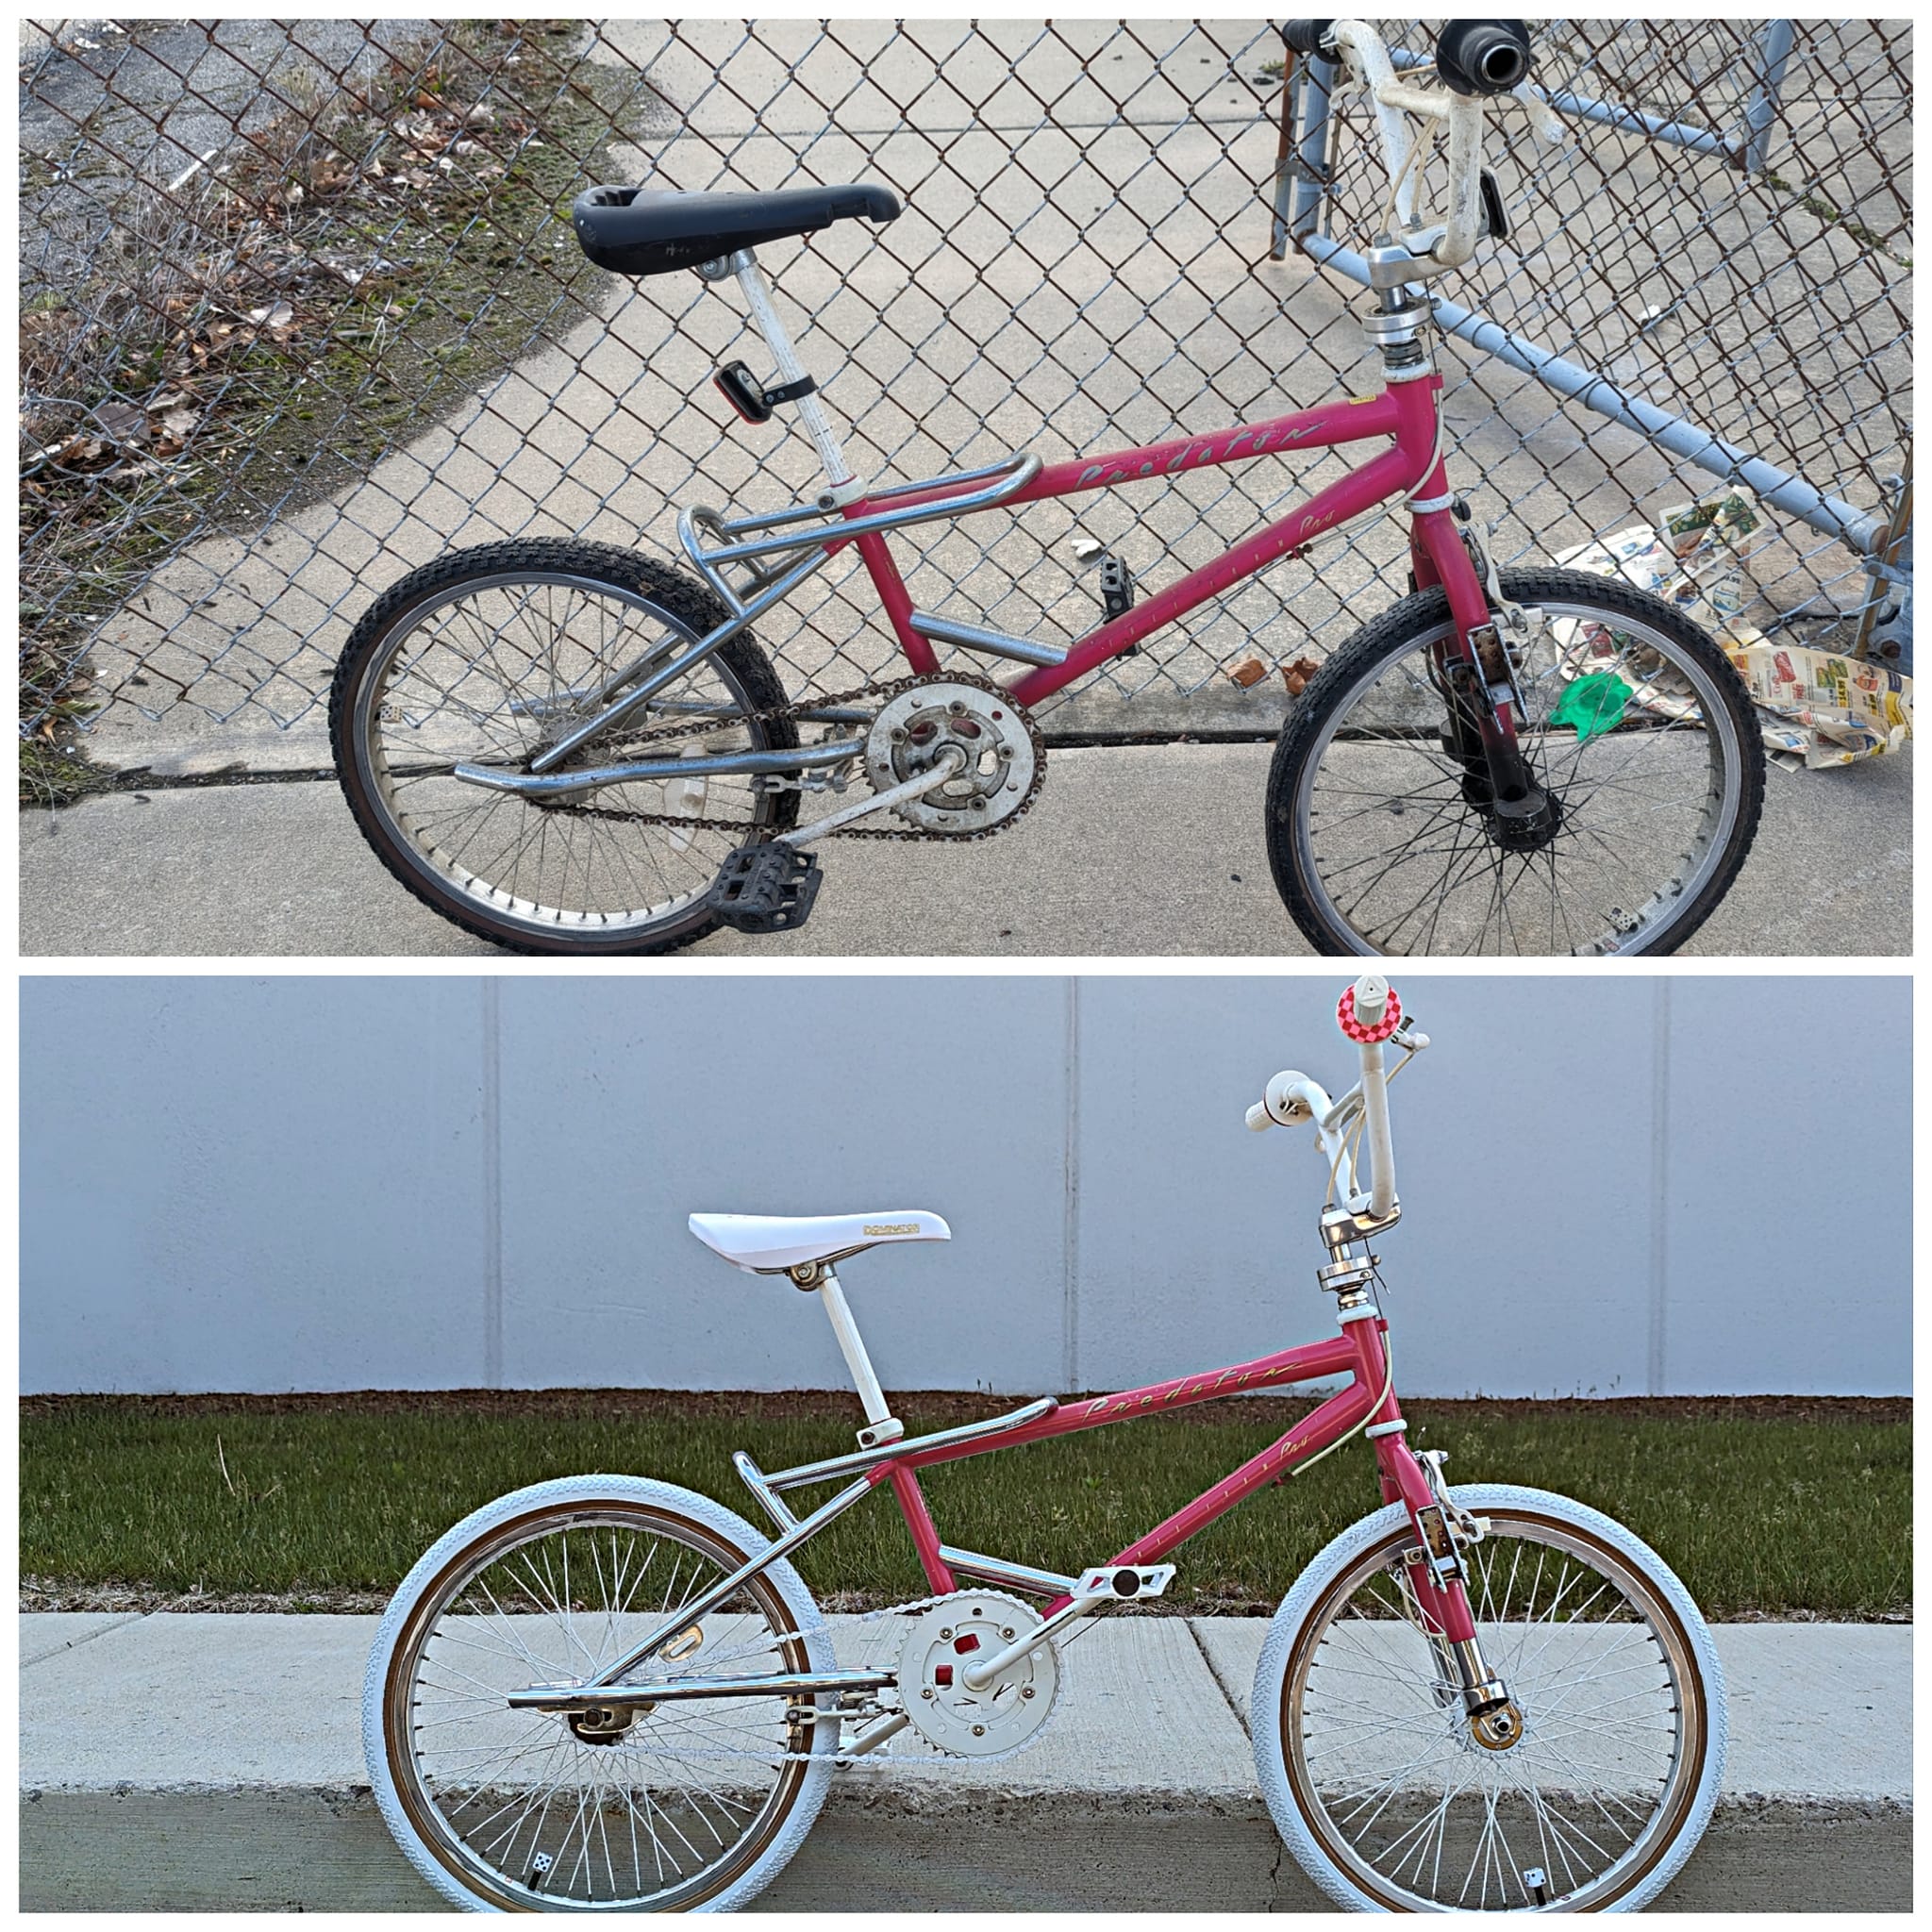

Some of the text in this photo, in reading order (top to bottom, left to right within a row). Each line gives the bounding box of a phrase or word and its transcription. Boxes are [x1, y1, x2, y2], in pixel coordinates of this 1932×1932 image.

[1074, 421, 1326, 491] Predator
[1300, 509, 1336, 537] Pro
[1082, 1362, 1300, 1423] Predator
[1279, 1435, 1309, 1460] Pro
